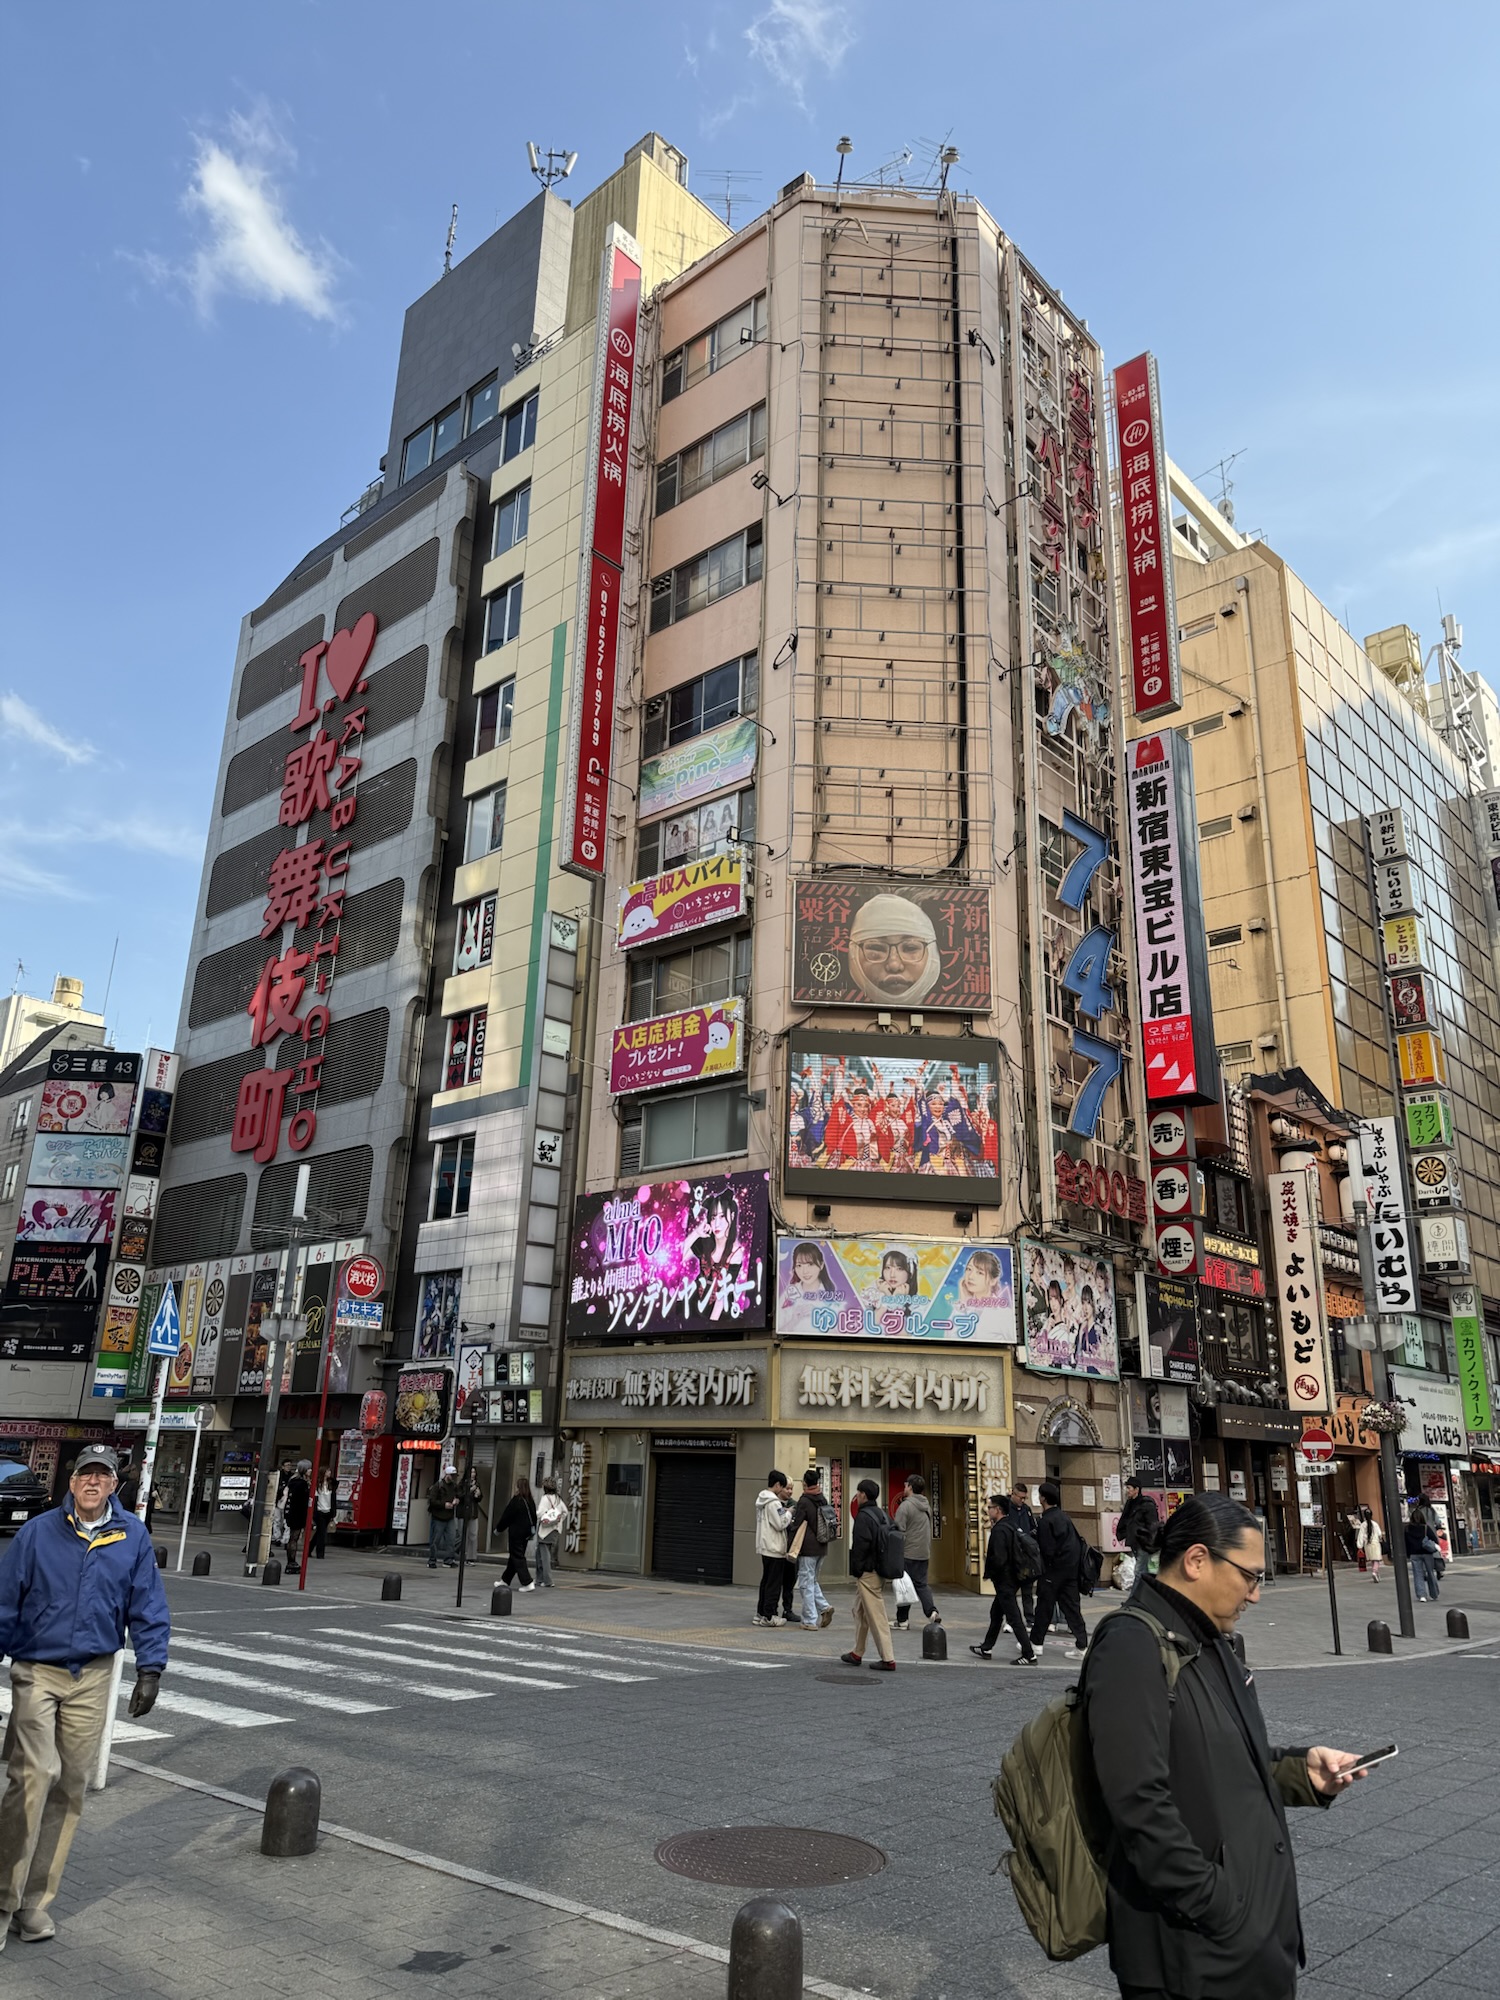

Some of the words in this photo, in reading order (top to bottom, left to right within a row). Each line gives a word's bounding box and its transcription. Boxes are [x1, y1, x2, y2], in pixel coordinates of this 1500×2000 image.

[1132, 760, 1171, 781] MARUHAN
[1379, 812, 1398, 856] 川新ビル
[641, 855, 742, 904] 高収入バイト
[1387, 866, 1403, 910] にいむら
[685, 886, 733, 911] いちごなび
[1135, 775, 1183, 1019] 新宿東宝ビル店
[481, 901, 495, 966] POKER
[231, 729, 338, 1164] 歌舞伎町
[962, 903, 991, 994] 新店舗
[808, 988, 843, 998] CERN
[614, 1013, 702, 1054] 入店応援金
[473, 1018, 487, 1080] HOUSE
[628, 1041, 685, 1069] プレゼント!
[113, 1061, 133, 1075] 43
[1435, 1186, 1449, 1195] UP
[604, 1198, 641, 1223] alma
[1281, 1180, 1300, 1243] 炭火焼き
[1428, 1197, 1441, 1207] 4F
[602, 1214, 663, 1265] MIO
[15, 1256, 67, 1264] INTERNATIONAL
[262, 1255, 273, 1268] 4F
[315, 1248, 326, 1263] 6F
[1163, 1258, 1191, 1266] CIGARETTE
[1374, 1201, 1411, 1305] にいむら
[12, 1263, 83, 1283] PLAY
[214, 1262, 225, 1277] 2F
[237, 1259, 248, 1274] 3F
[1438, 1261, 1449, 1271] 3F
[349, 1269, 377, 1288] 消火栓
[125, 1295, 139, 1304] UP
[350, 1301, 383, 1317] セキネ
[1285, 1252, 1316, 1364] よいもど
[110, 1309, 133, 1322] 300
[203, 1315, 221, 1326] Darts
[200, 1326, 218, 1347] UP
[71, 1344, 85, 1354] 2F
[97, 1371, 127, 1381] FamilyMart
[566, 1377, 619, 1400] 歌舞伎町
[621, 1364, 756, 1407] 無料案内所
[798, 1364, 991, 1413] 無料案内所
[159, 1416, 184, 1424] FamilyMart
[1423, 1424, 1462, 1447] にいむら
[1134, 1455, 1156, 1471] alma
[564, 1441, 588, 1553] 無料案内所
